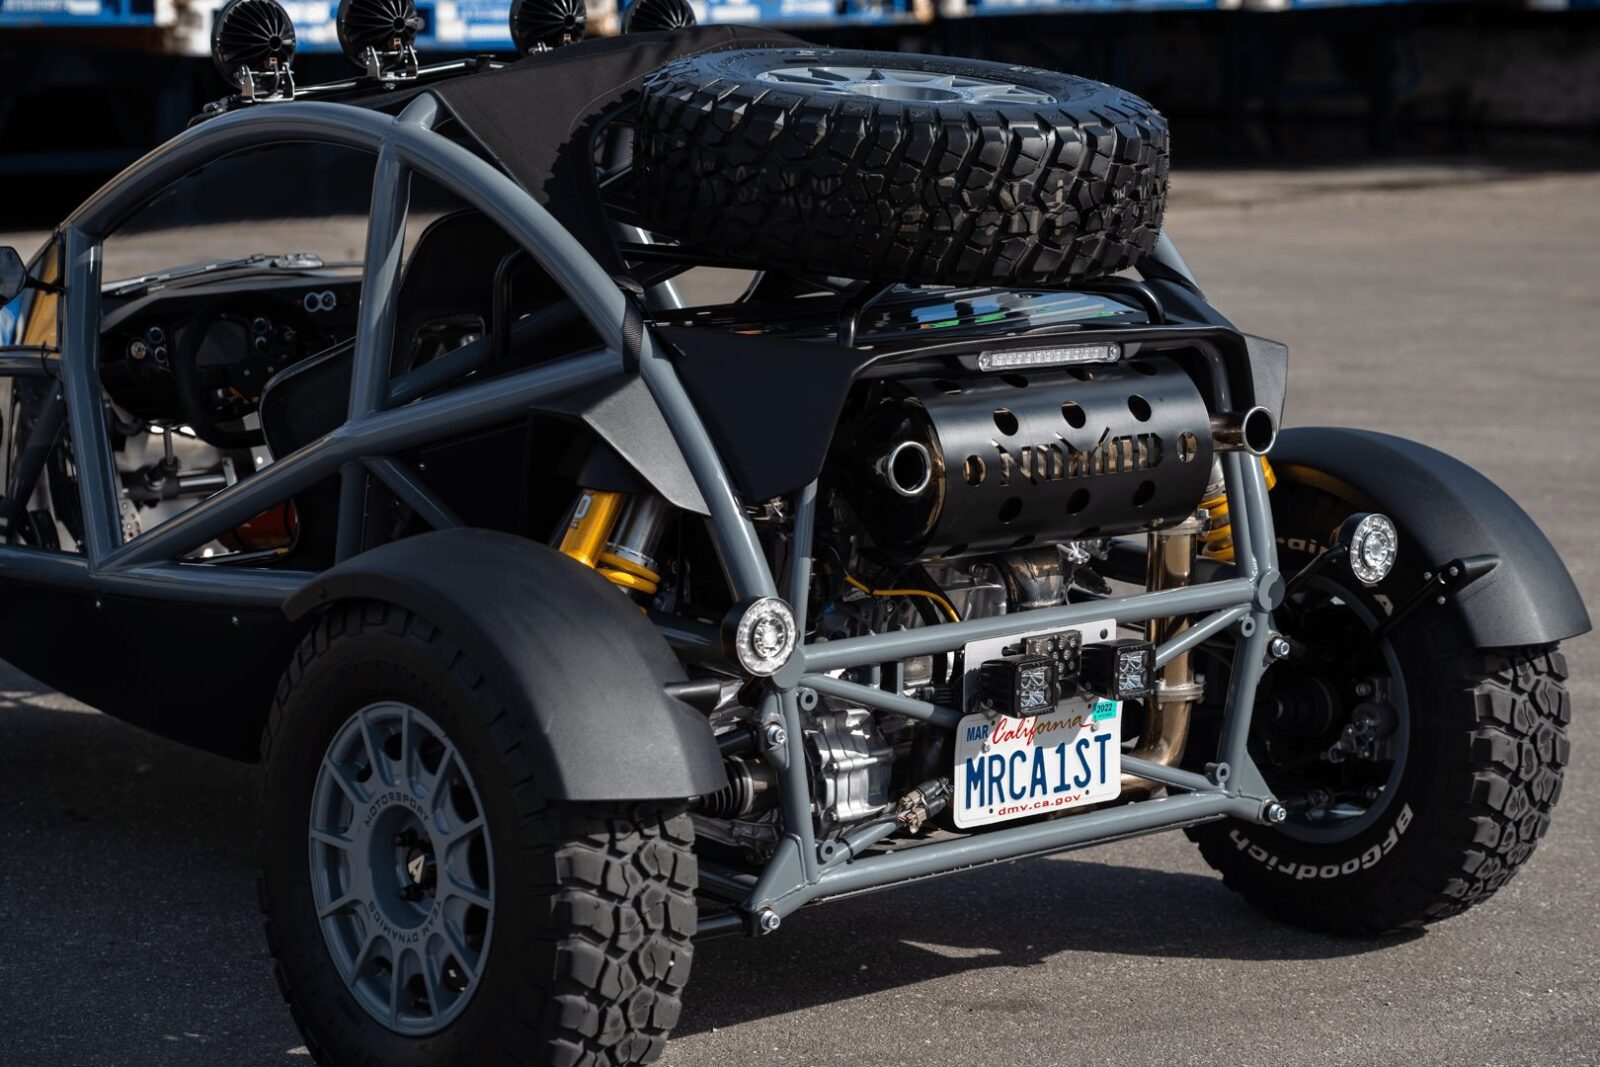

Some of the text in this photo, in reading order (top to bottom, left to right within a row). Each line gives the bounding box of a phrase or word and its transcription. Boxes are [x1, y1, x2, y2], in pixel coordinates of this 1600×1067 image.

[1096, 703, 1113, 713] 2022
[966, 724, 989, 742] MAR
[992, 714, 1093, 746] California
[965, 733, 1112, 810] MRCA1ST
[364, 791, 430, 827] MOTORSPORT
[998, 793, 1081, 816] dmv.ca.gov
[1228, 802, 1415, 881] BFGoodrich
[368, 900, 442, 944] TEAM DYNAMICS
